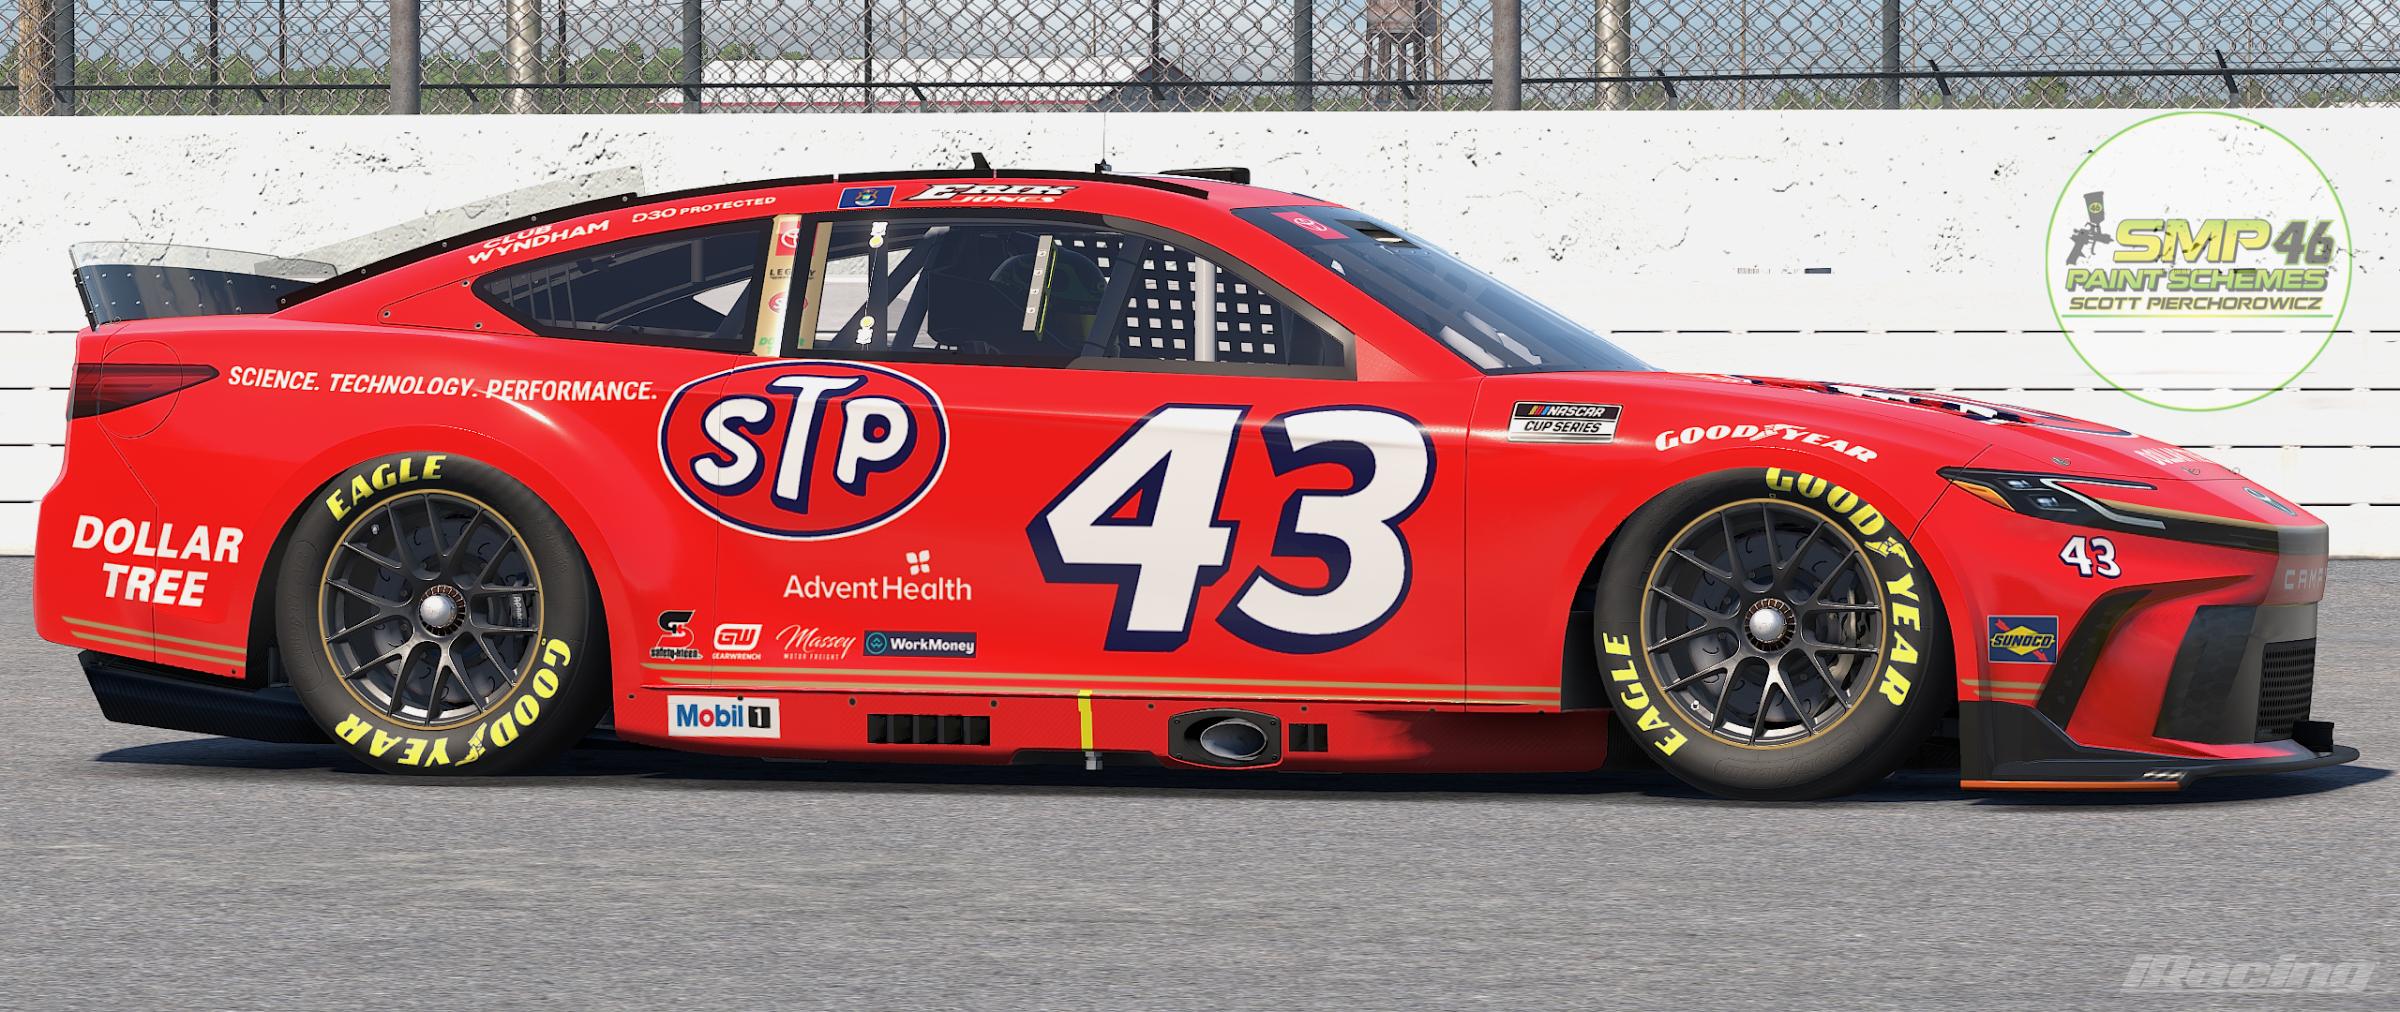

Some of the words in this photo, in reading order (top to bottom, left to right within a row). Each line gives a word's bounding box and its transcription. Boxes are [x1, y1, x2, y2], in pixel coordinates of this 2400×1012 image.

[679, 196, 776, 216] PROTECTED
[907, 183, 1079, 201] ERIK
[467, 219, 610, 264] WYNDHAM
[483, 224, 553, 249] CLUB
[228, 365, 320, 391] SCIENCE.
[329, 373, 478, 398] TECHNOLOGY.
[485, 379, 657, 401] PERFORMANCE.
[1524, 421, 1552, 432] CUP
[1552, 421, 1603, 433] SERIES
[1546, 405, 1606, 418] NASCAR
[691, 376, 917, 513] STP
[326, 455, 447, 522] EAGLE
[72, 514, 244, 563] DOLLAR
[1027, 403, 1437, 654] 43
[2059, 535, 2122, 579] 43
[102, 562, 209, 608] TREE
[776, 624, 856, 660] Massey
[890, 637, 975, 655] WorkMoney
[1993, 635, 2053, 648] SUNOCO
[1602, 633, 1688, 756] EAGLE
[676, 704, 744, 727] Mobil
